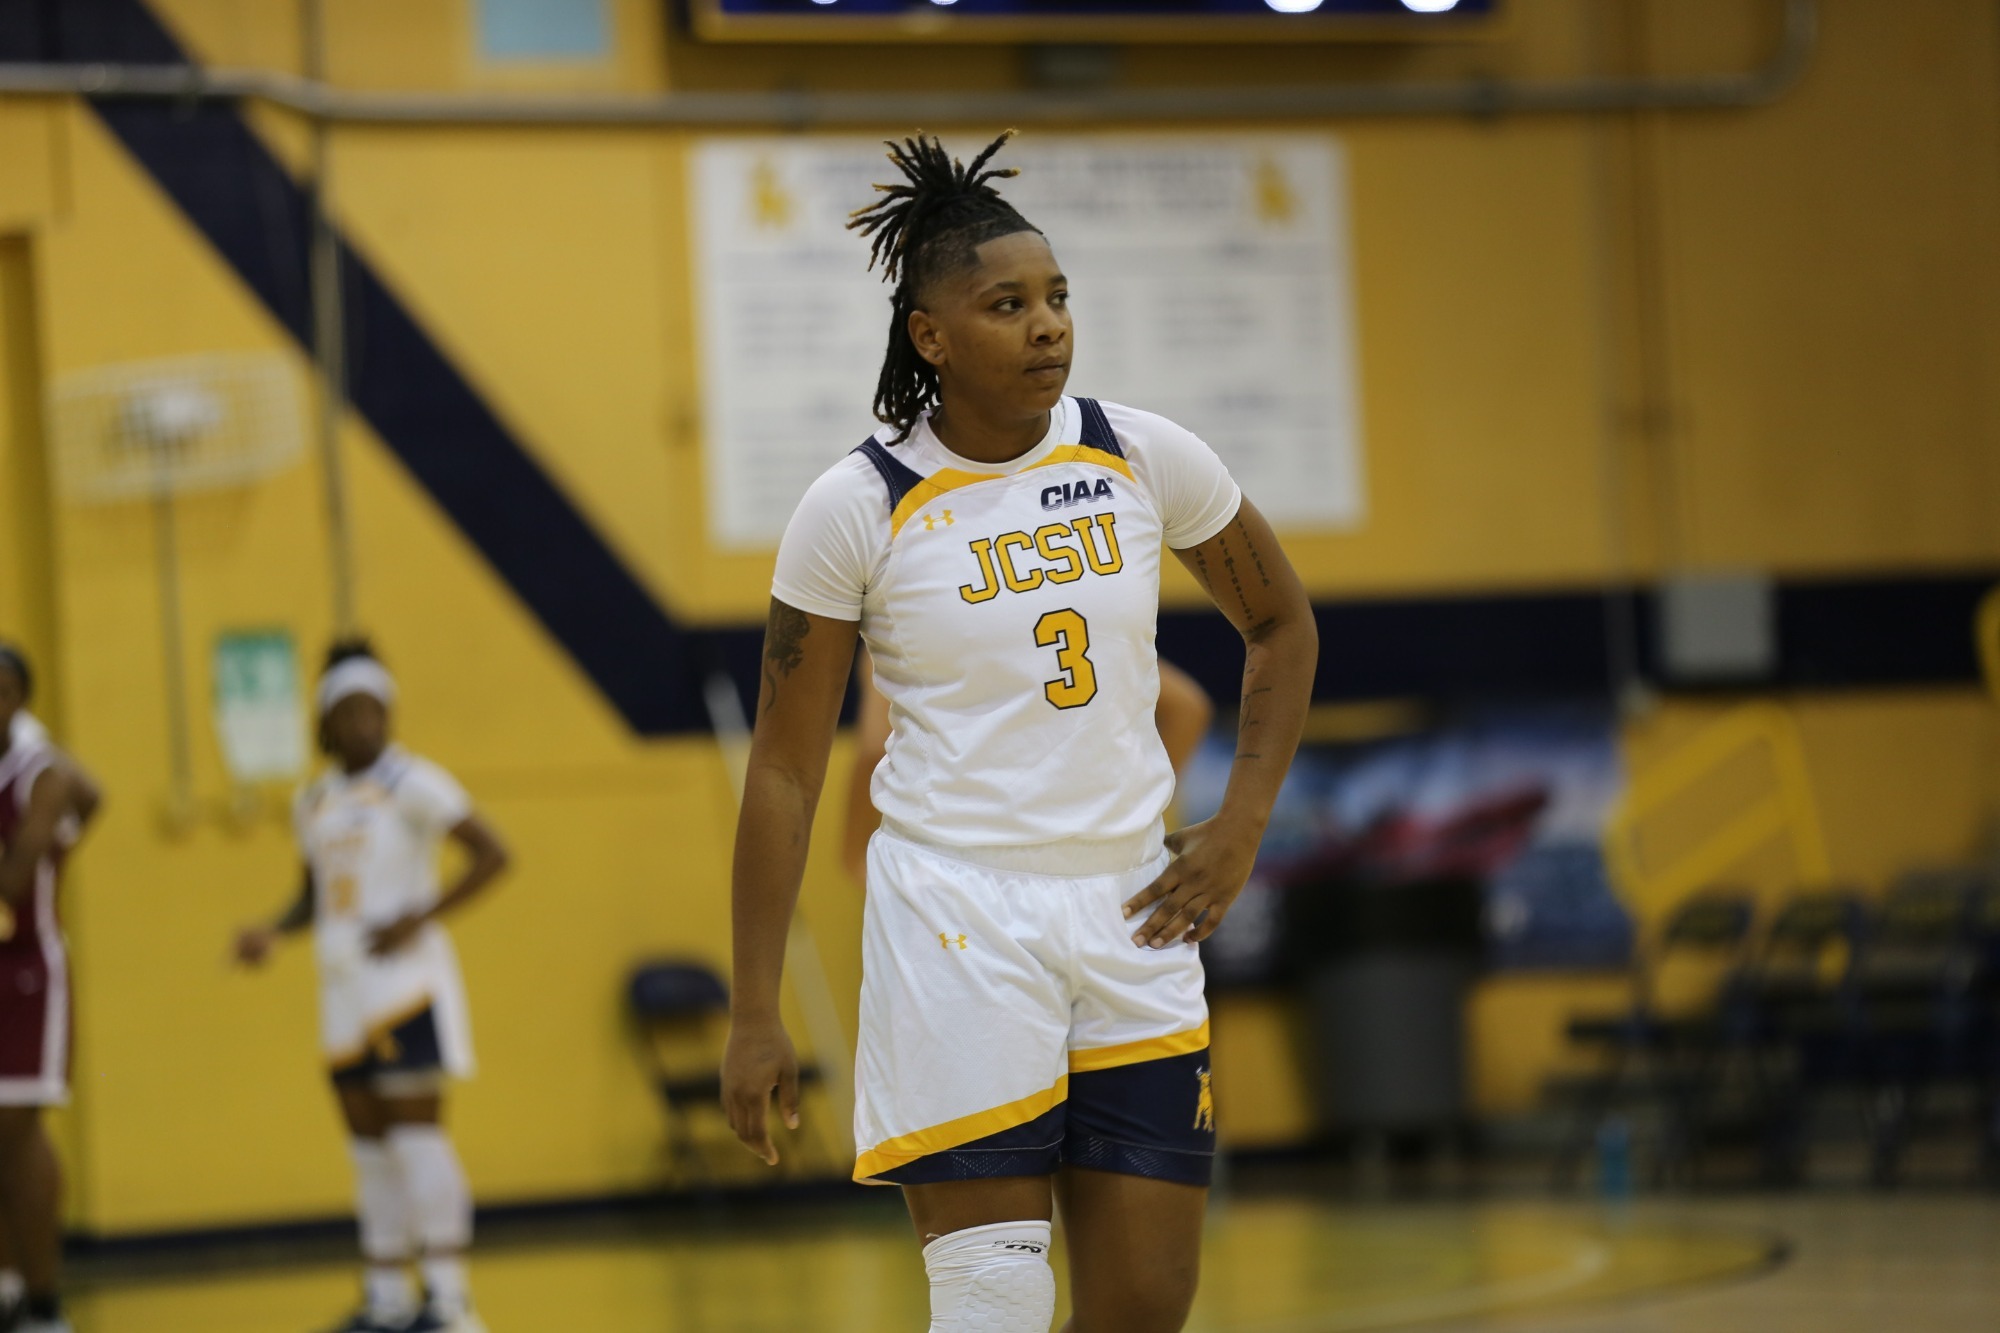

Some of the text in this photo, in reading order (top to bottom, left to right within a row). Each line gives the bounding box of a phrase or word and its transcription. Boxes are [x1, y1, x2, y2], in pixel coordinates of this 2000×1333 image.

[1041, 478, 1115, 512] CIAA
[959, 512, 1123, 604] JCSU
[1033, 608, 1097, 710] 3
